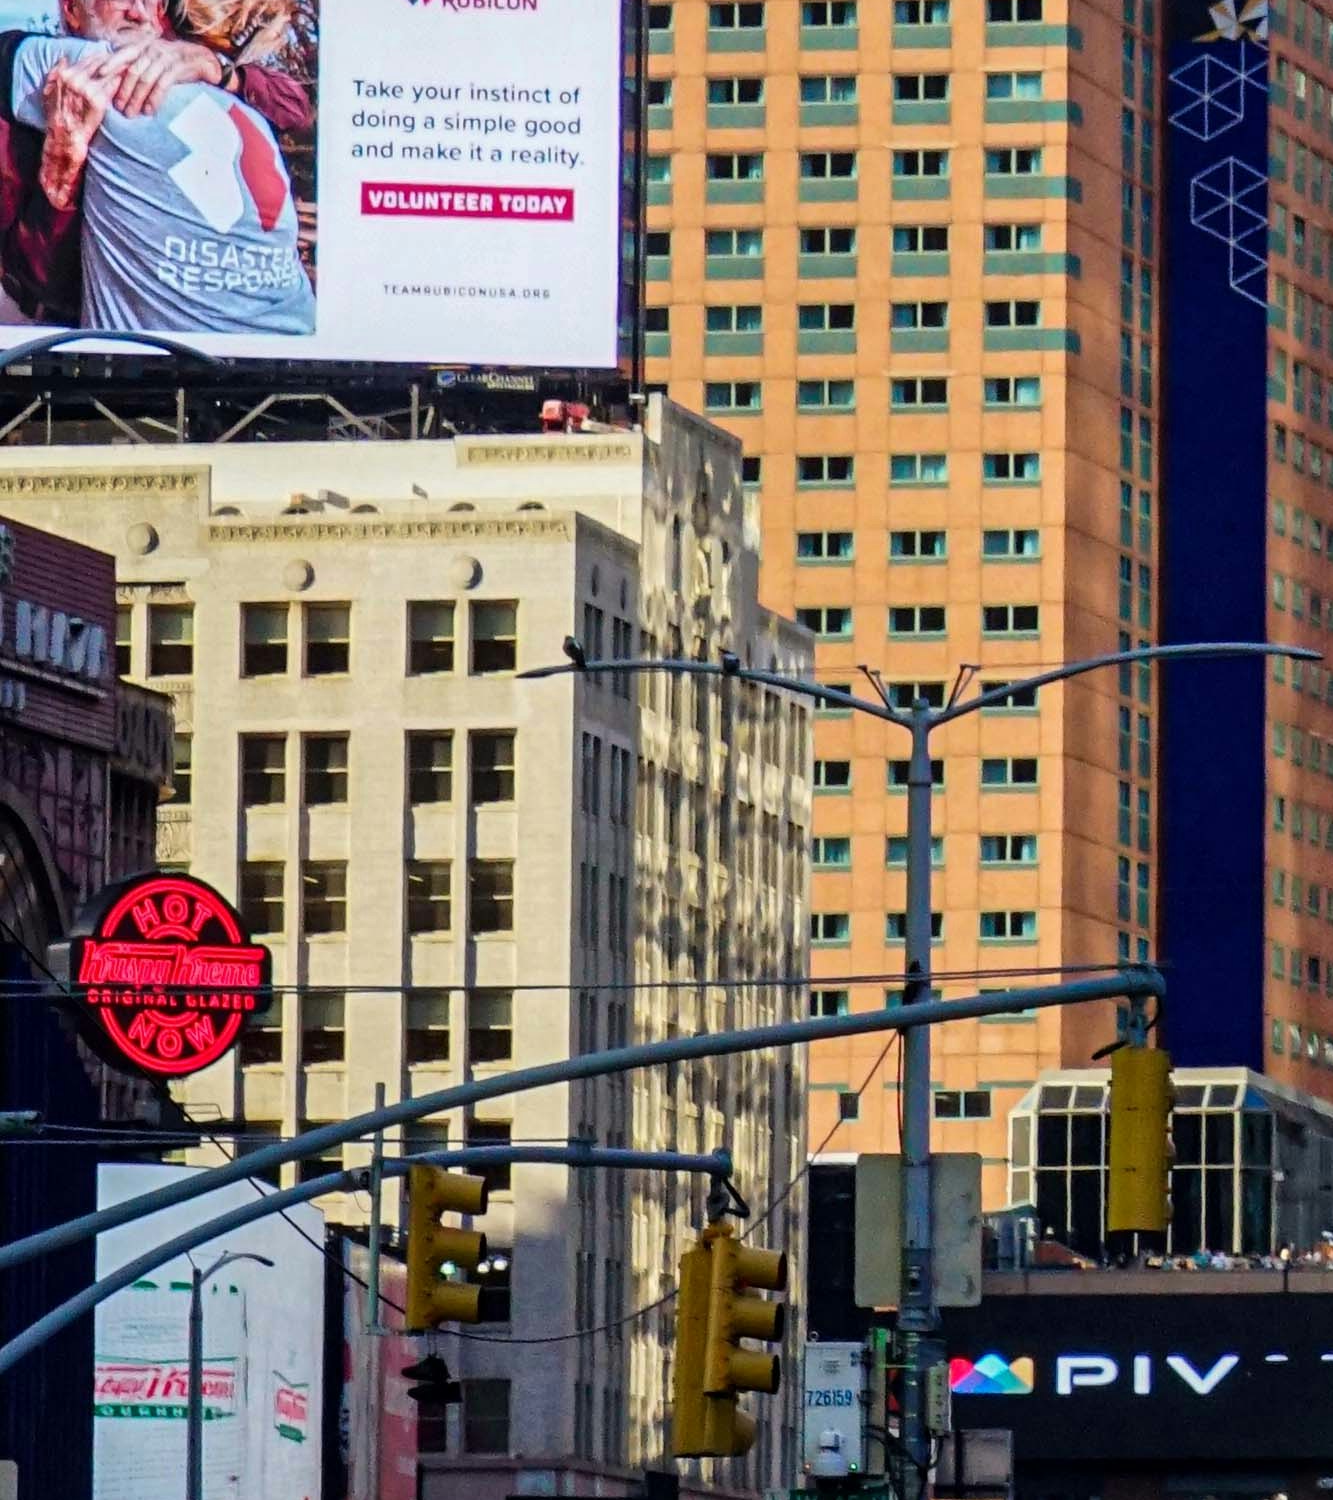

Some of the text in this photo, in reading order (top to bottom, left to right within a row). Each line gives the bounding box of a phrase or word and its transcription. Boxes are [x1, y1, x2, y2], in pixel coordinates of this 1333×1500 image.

[353, 79, 582, 105] Take your instinct of
[351, 111, 582, 138] doing a simple good
[351, 141, 585, 170] and make it a reality.
[369, 190, 567, 214] VOLUNTEER TODAY
[132, 894, 212, 933] HOT
[87, 988, 255, 1011] ORIGINAL GLAZED
[128, 1011, 215, 1059] NOW
